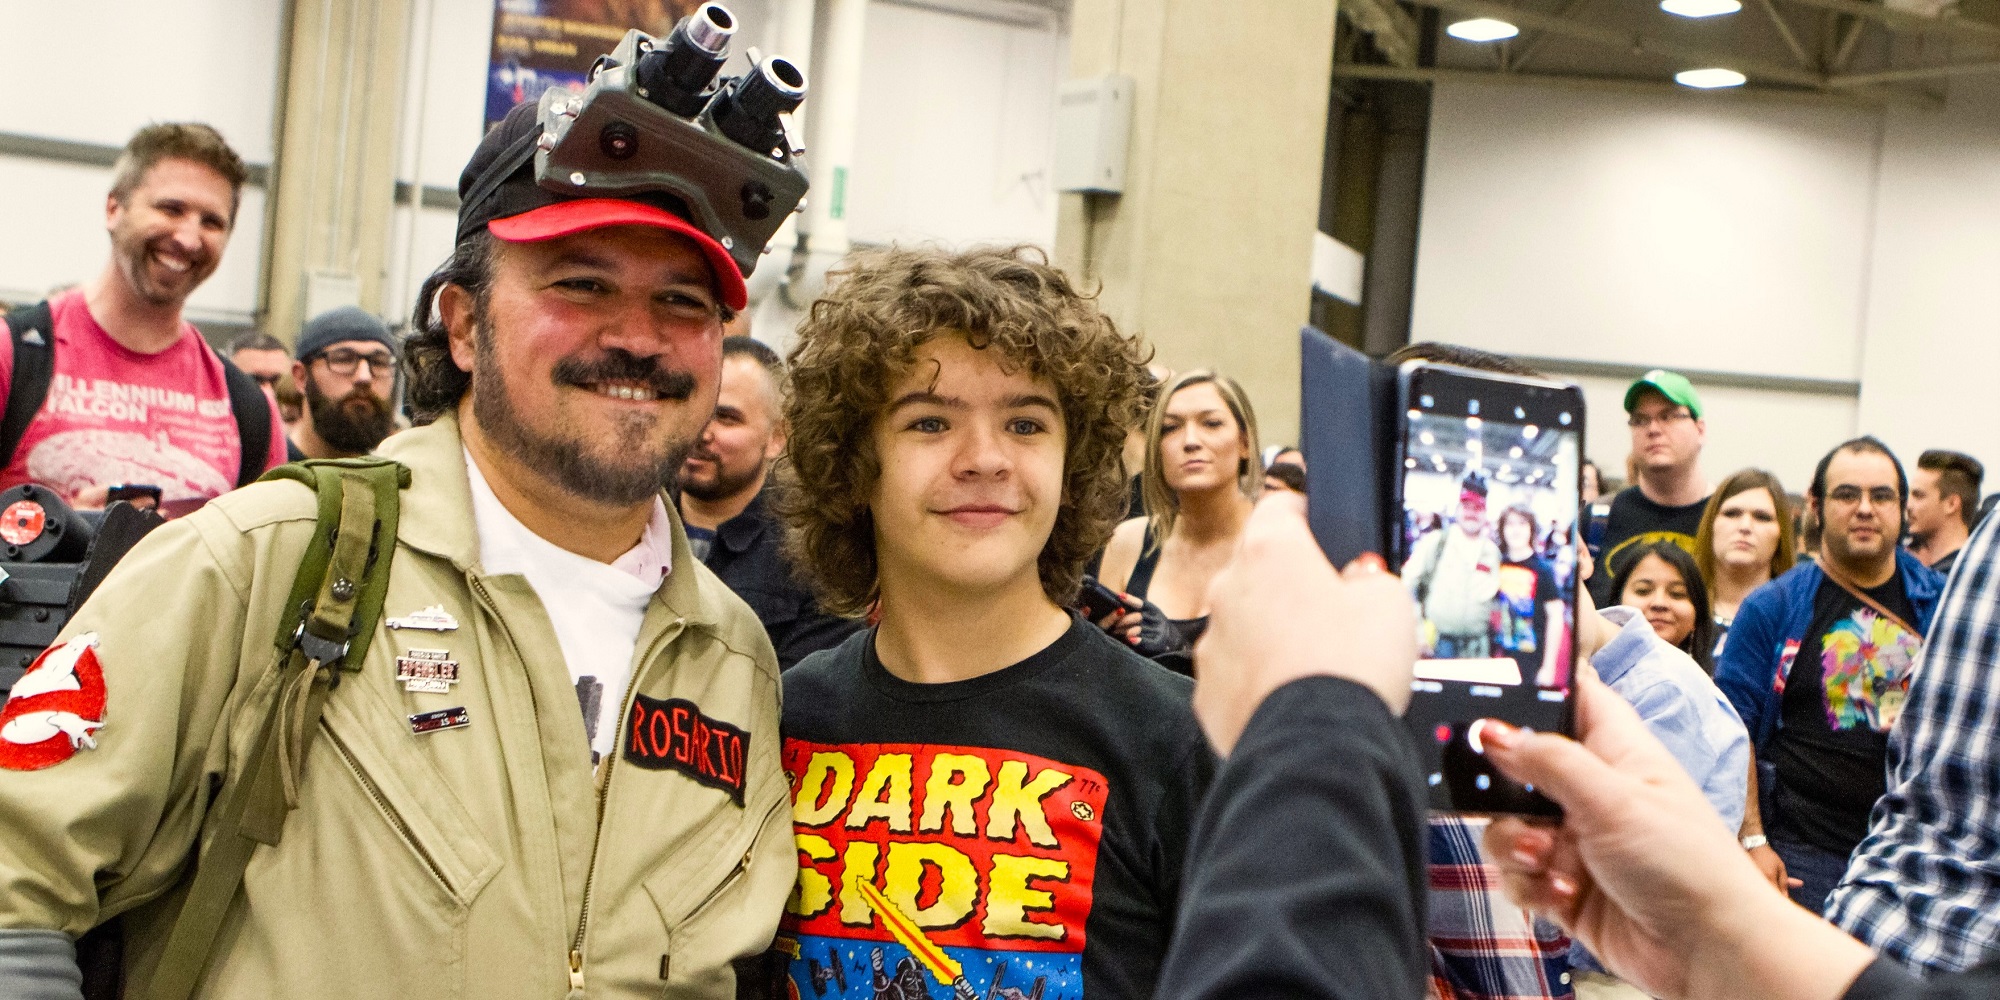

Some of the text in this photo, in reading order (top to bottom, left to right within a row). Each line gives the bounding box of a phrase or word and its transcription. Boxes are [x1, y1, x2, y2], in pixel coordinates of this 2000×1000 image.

[53, 372, 196, 413] ILLENNIUM
[631, 700, 743, 789] ROSARIO
[793, 750, 1075, 850] DARK
[786, 832, 1071, 941] SIDE
